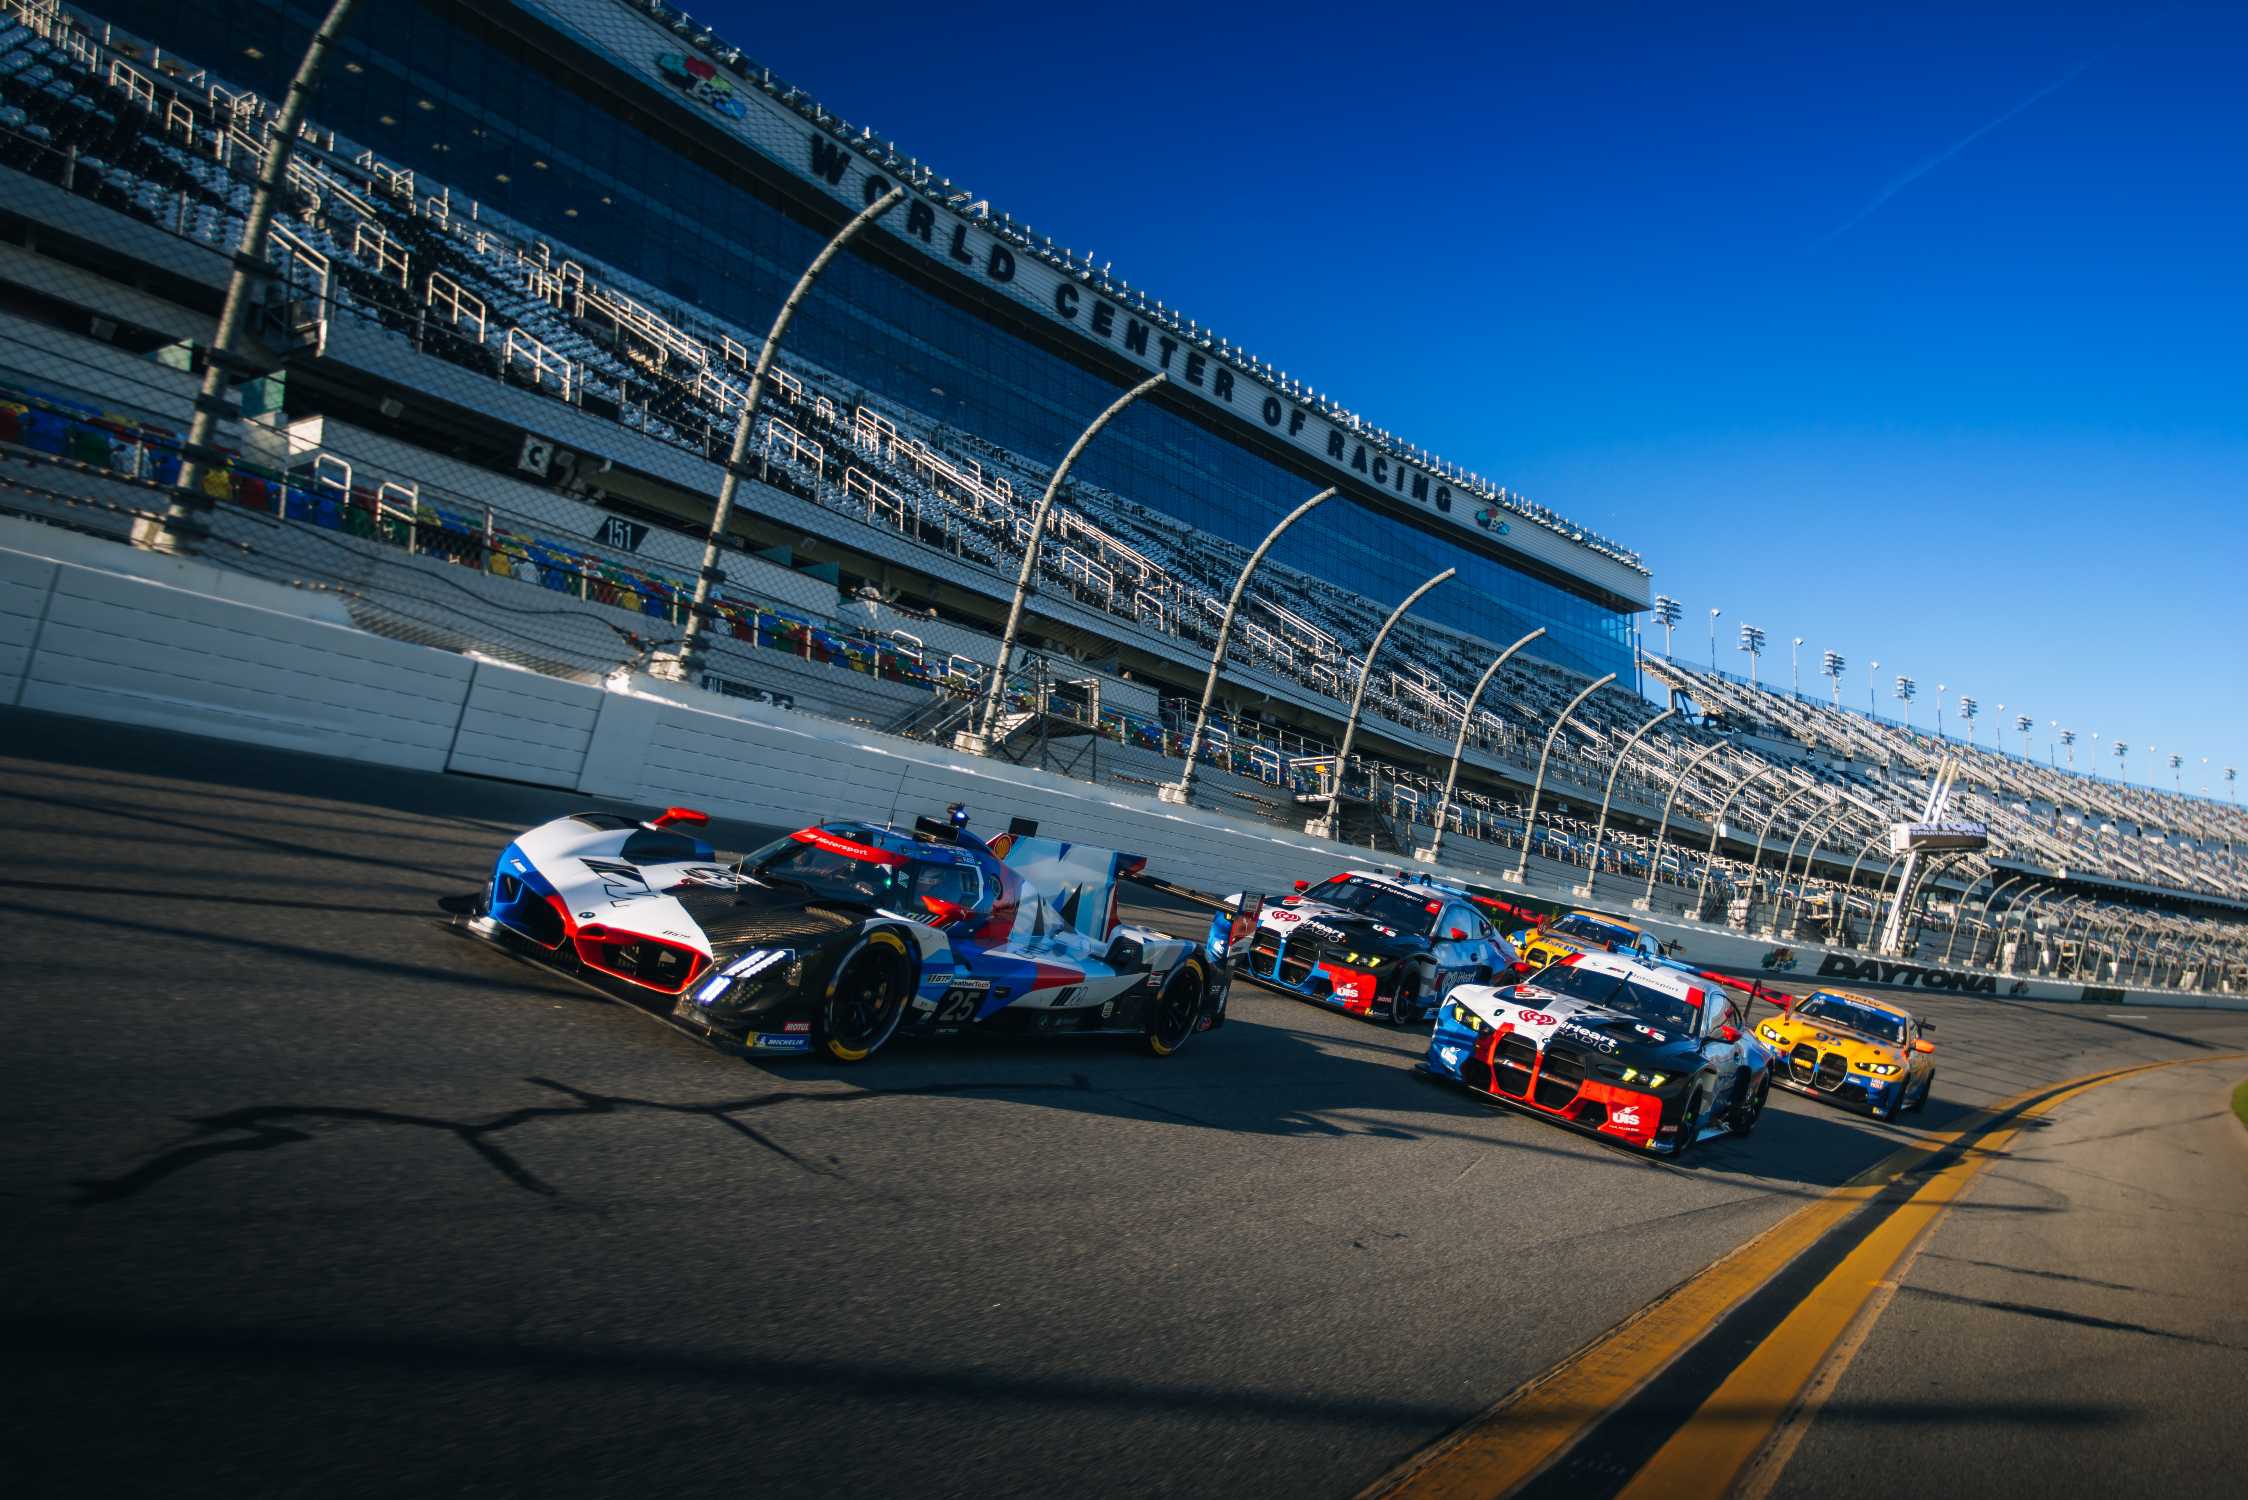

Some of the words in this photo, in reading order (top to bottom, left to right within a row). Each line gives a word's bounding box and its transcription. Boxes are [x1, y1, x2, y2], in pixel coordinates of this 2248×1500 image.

[811, 132, 1016, 283] WORLD
[1055, 283, 1235, 403] CENTER
[1263, 396, 1307, 437] OF
[1327, 429, 1452, 513] RACING
[606, 518, 632, 550] 151
[816, 837, 868, 856] Motorsport
[1816, 953, 1998, 993] DAYTONA
[939, 990, 980, 1021] 25
[785, 1022, 810, 1032] MOTUL
[1560, 1022, 1617, 1048] iHeart
[767, 1038, 806, 1046] MICHELIN
